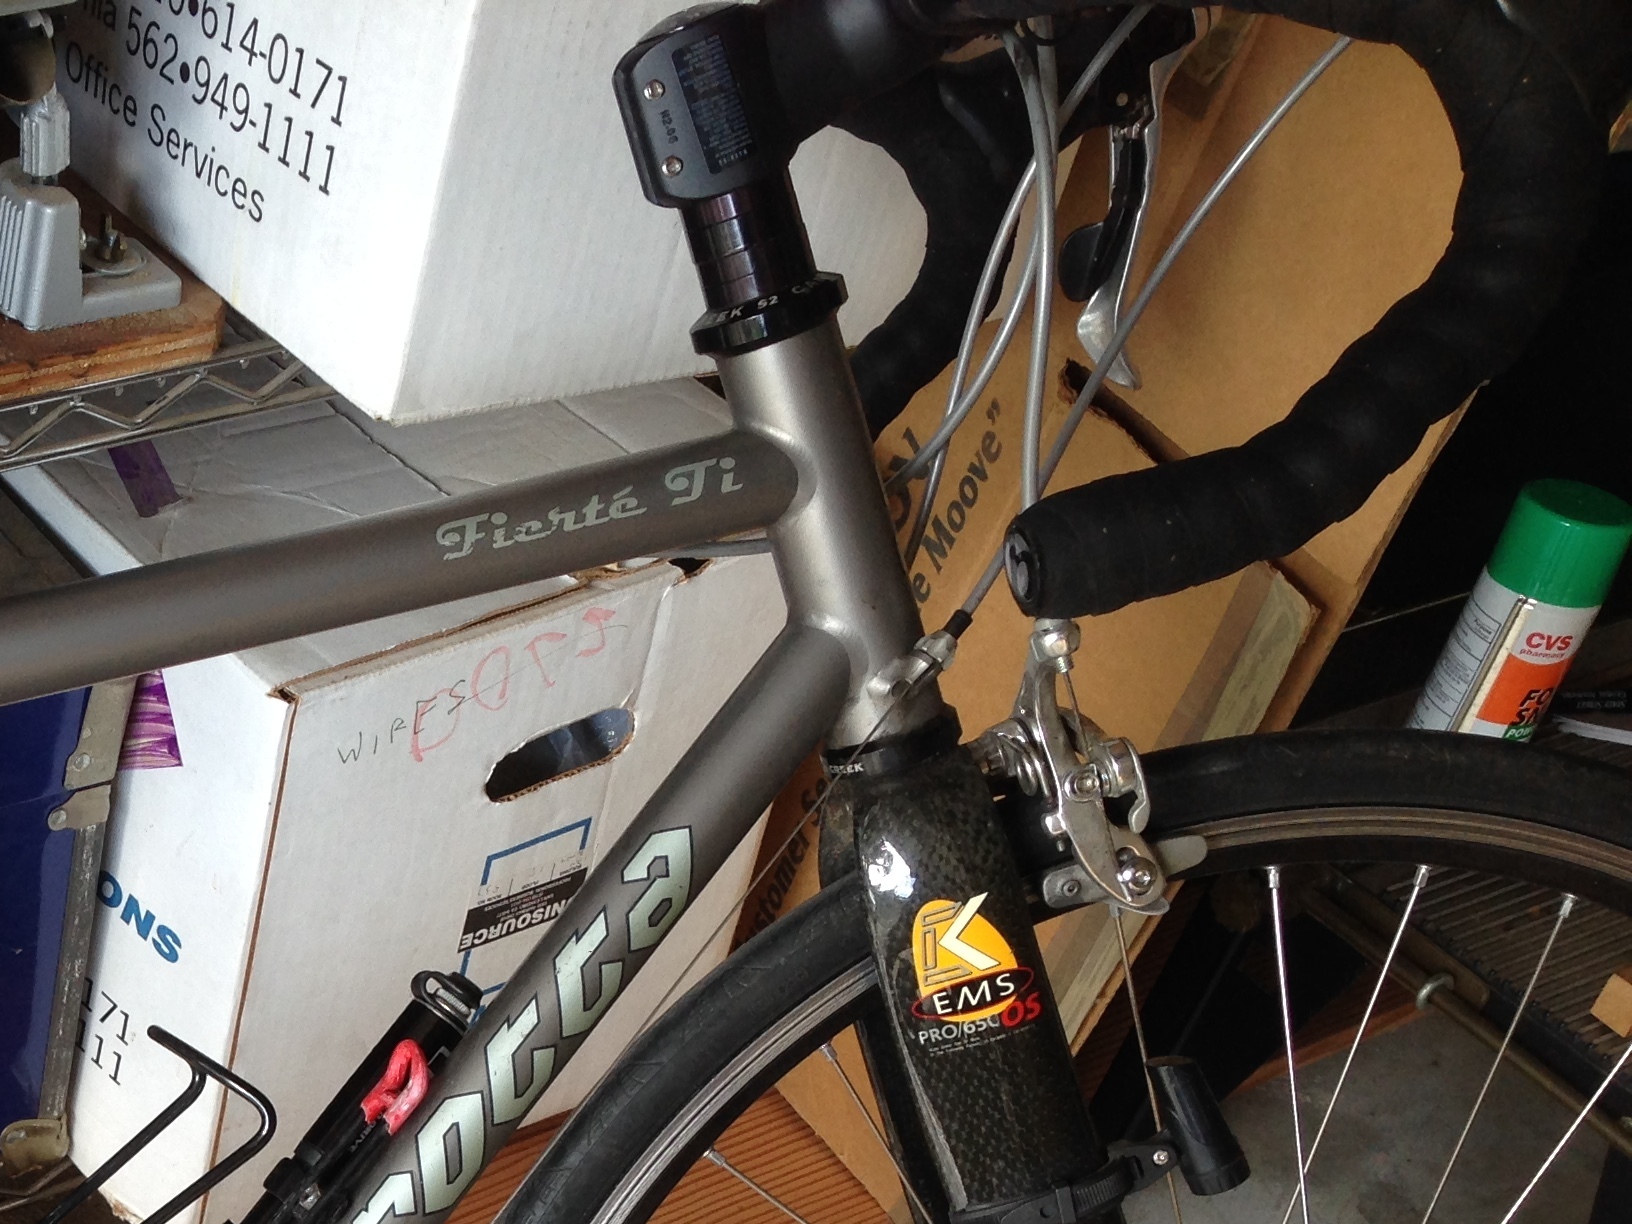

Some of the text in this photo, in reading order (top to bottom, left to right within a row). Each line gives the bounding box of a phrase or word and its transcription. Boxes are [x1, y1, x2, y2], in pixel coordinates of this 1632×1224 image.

[65, 41, 265, 223] Office Services
[436, 456, 744, 561] Fierté Ti
[1519, 648, 1566, 659] pharmacy
[1526, 632, 1573, 651] CVS
[460, 898, 568, 950] NISOURCE
[932, 973, 1015, 1016] EMS
